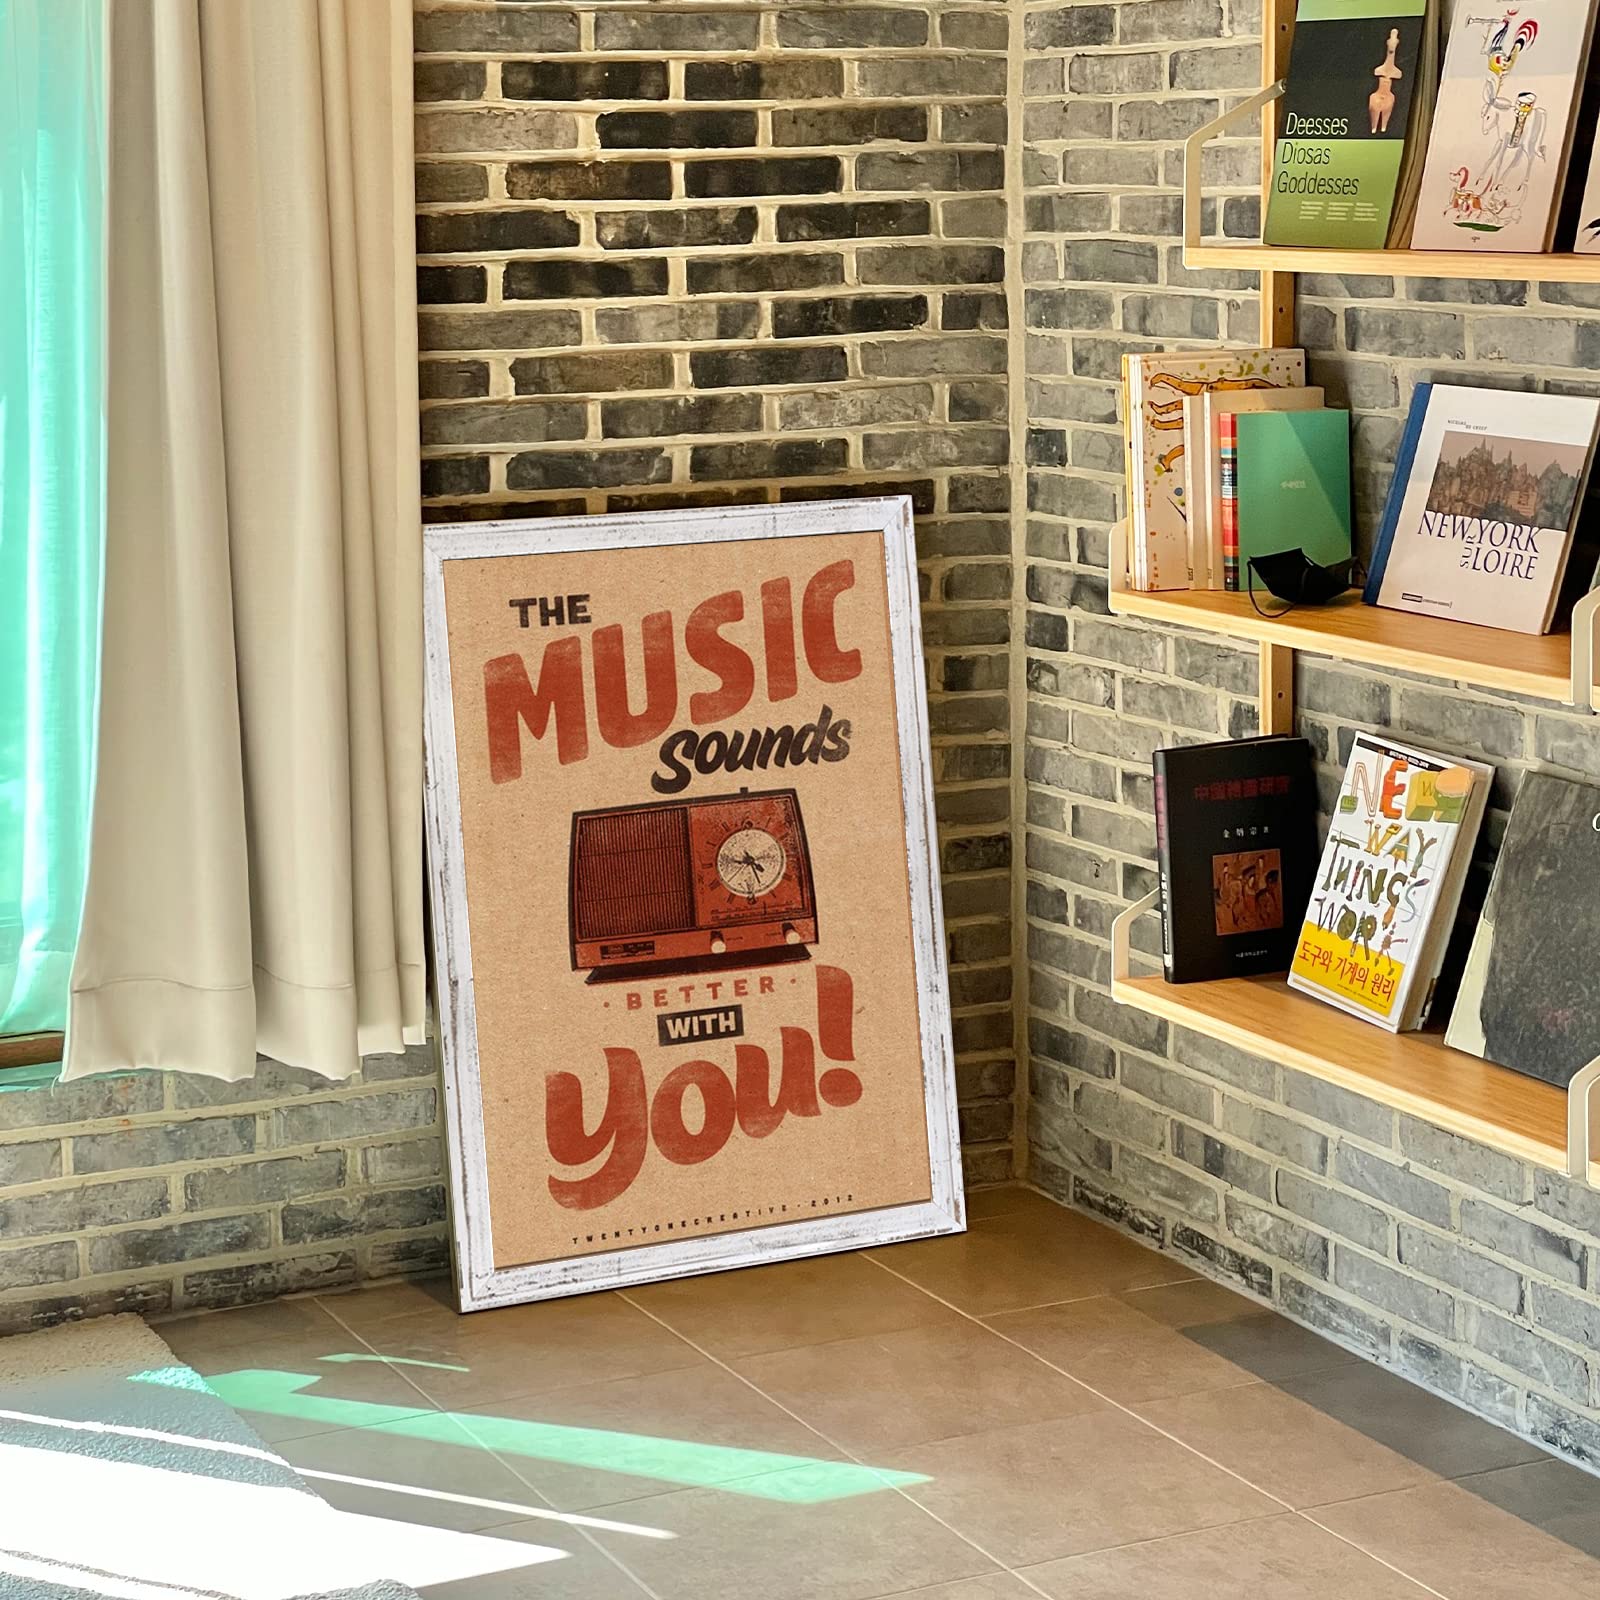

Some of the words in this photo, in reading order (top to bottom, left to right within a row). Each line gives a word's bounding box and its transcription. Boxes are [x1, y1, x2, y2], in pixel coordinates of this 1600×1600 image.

[1285, 112, 1349, 136] Deesses
[1281, 141, 1332, 165] Diosas
[1277, 170, 1360, 196] Goddesses
[1417, 510, 1473, 541] NEW
[1477, 518, 1541, 554] YORK
[1459, 534, 1477, 569] SUR
[1471, 546, 1539, 580] LOIRE
[508, 594, 592, 629] THE
[483, 559, 863, 785] MUSIC
[1364, 818, 1438, 879] WAY
[1298, 940, 1333, 974] 도구와
[1334, 956, 1370, 991] 기계의
[1370, 972, 1396, 1003] 원리
[626, 976, 775, 1010] BETTER
[665, 1011, 737, 1040] WITH
[544, 964, 864, 1211] you!
